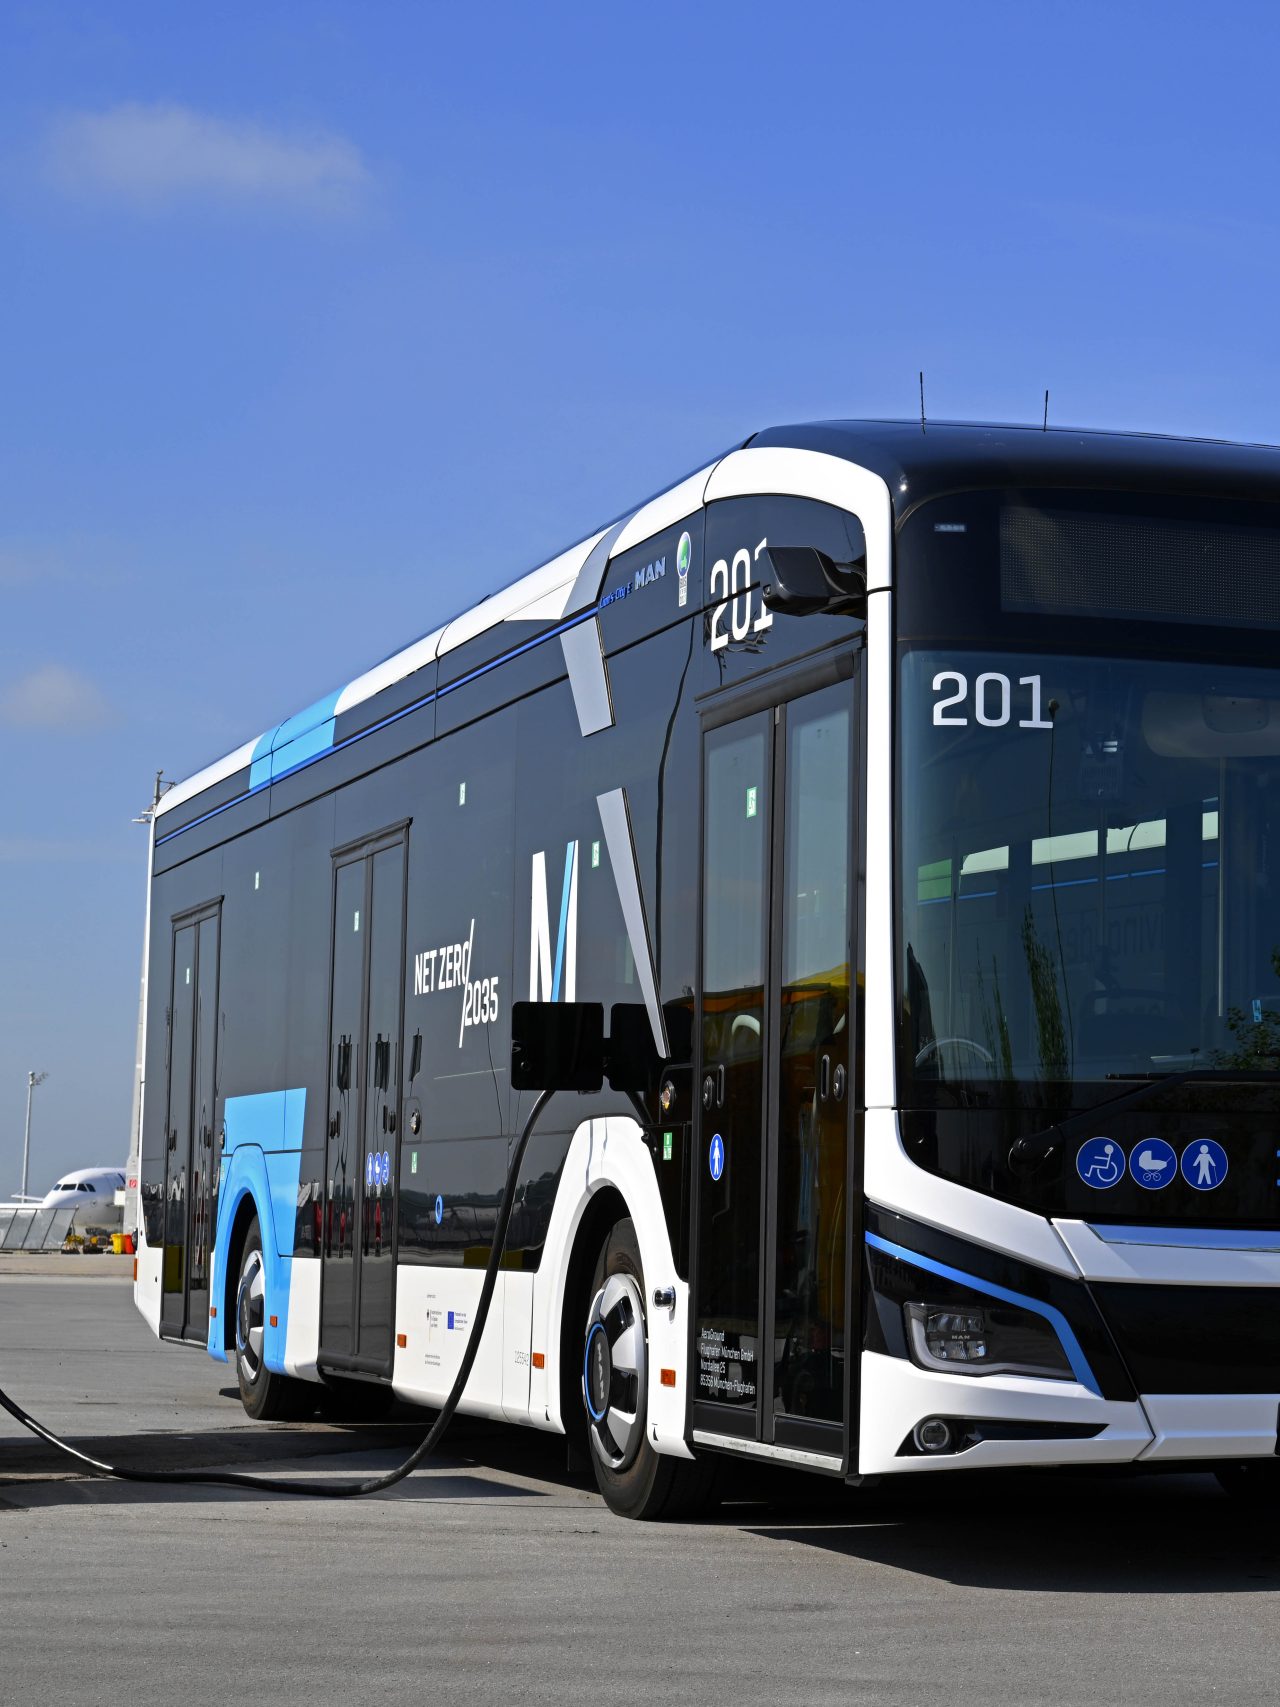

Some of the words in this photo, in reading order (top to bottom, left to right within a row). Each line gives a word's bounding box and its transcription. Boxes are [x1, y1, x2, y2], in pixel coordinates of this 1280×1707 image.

[634, 556, 666, 590] MAN
[932, 671, 1054, 729] 201
[414, 949, 438, 996] NET
[438, 940, 471, 991] ZERO
